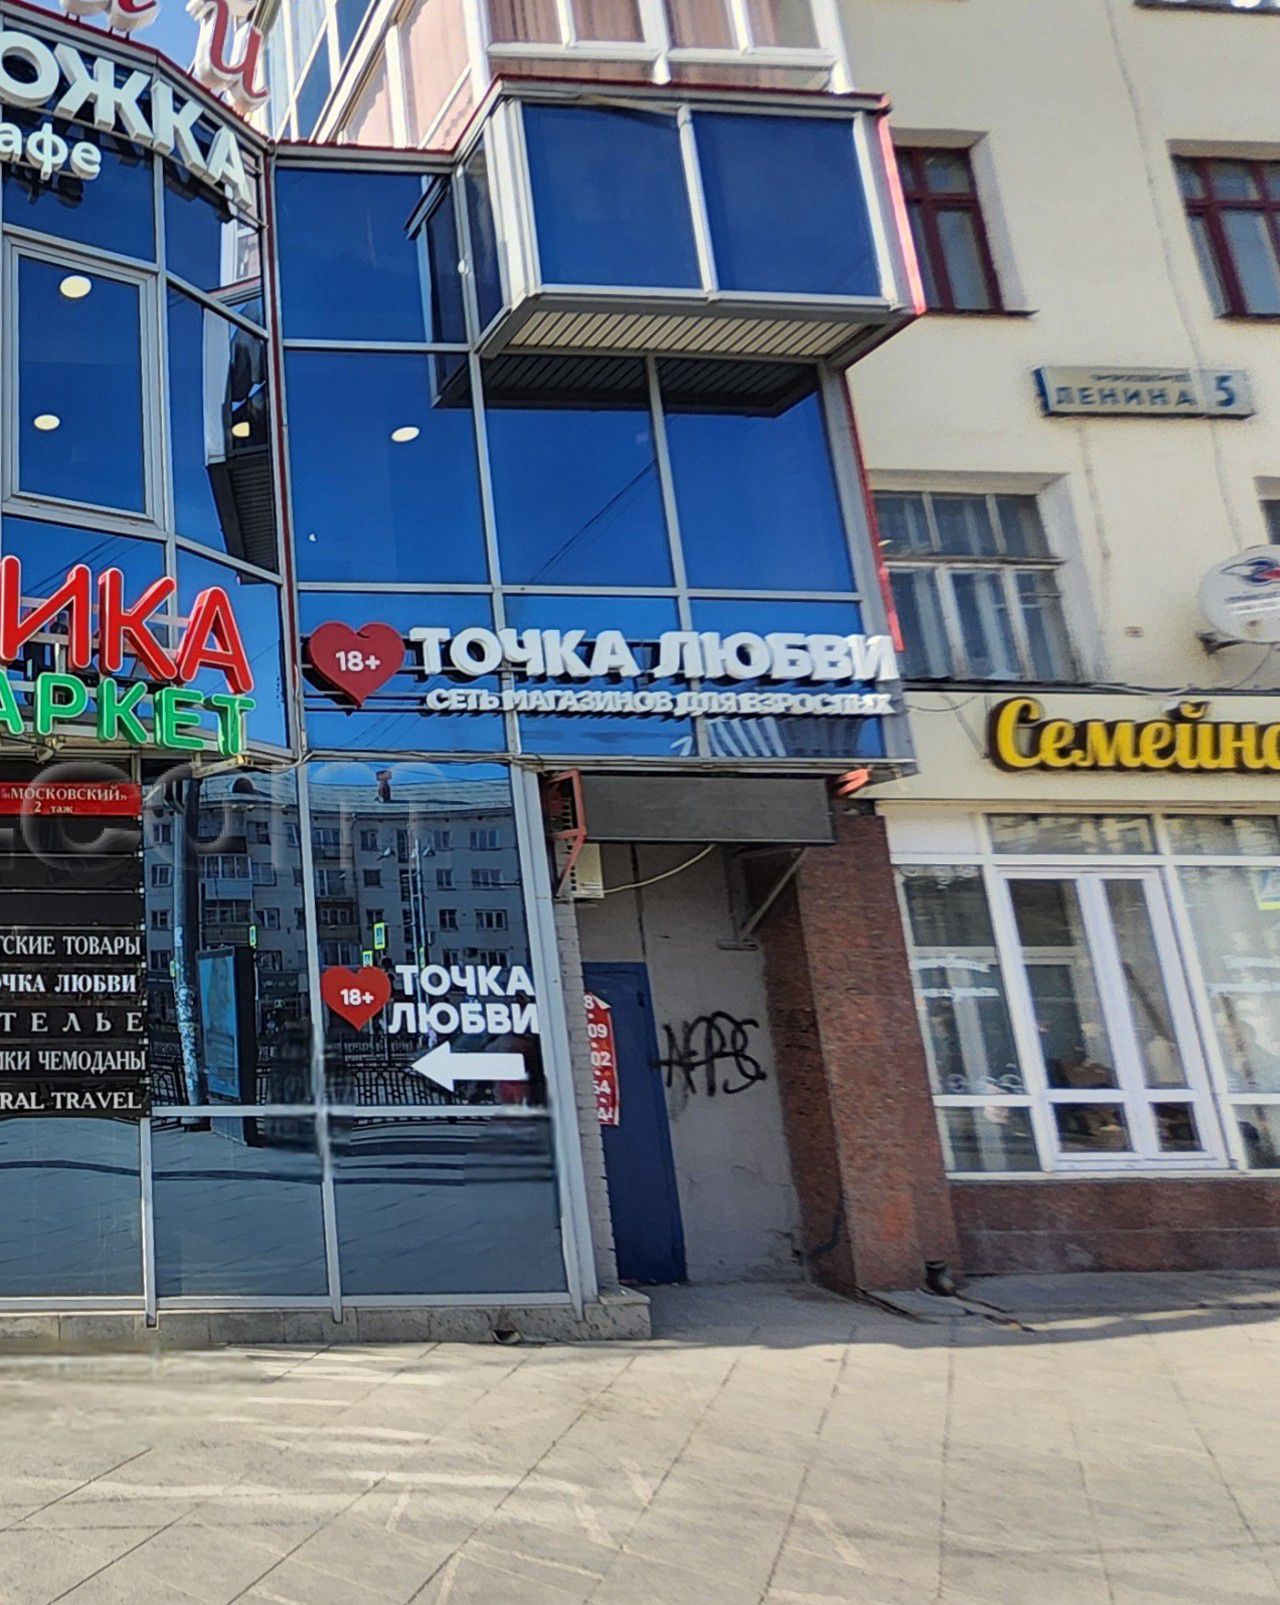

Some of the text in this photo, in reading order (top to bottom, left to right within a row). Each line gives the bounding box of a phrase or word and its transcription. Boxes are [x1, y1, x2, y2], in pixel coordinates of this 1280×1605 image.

[1055, 374, 1236, 407] ЛЕНИНА 5
[335, 650, 381, 672] 18+
[409, 627, 900, 681] ТОЧКА ЛЮБВИ
[425, 688, 500, 711] СЕТЬ
[502, 689, 674, 714] МАГАЗИНОВ
[673, 691, 737, 716] ДЛЯ
[34, 801, 42, 813] 2
[62, 935, 141, 955] ТОВАРЫ
[54, 974, 137, 994] ЛЮБВИ
[395, 965, 535, 996] ТОЧКА
[340, 988, 374, 1006] 18+
[388, 1002, 540, 1034] ЛЮБВИ
[38, 1050, 147, 1076] ЧЕМОДАНЫ
[51, 1092, 143, 1111] TRAVEL
